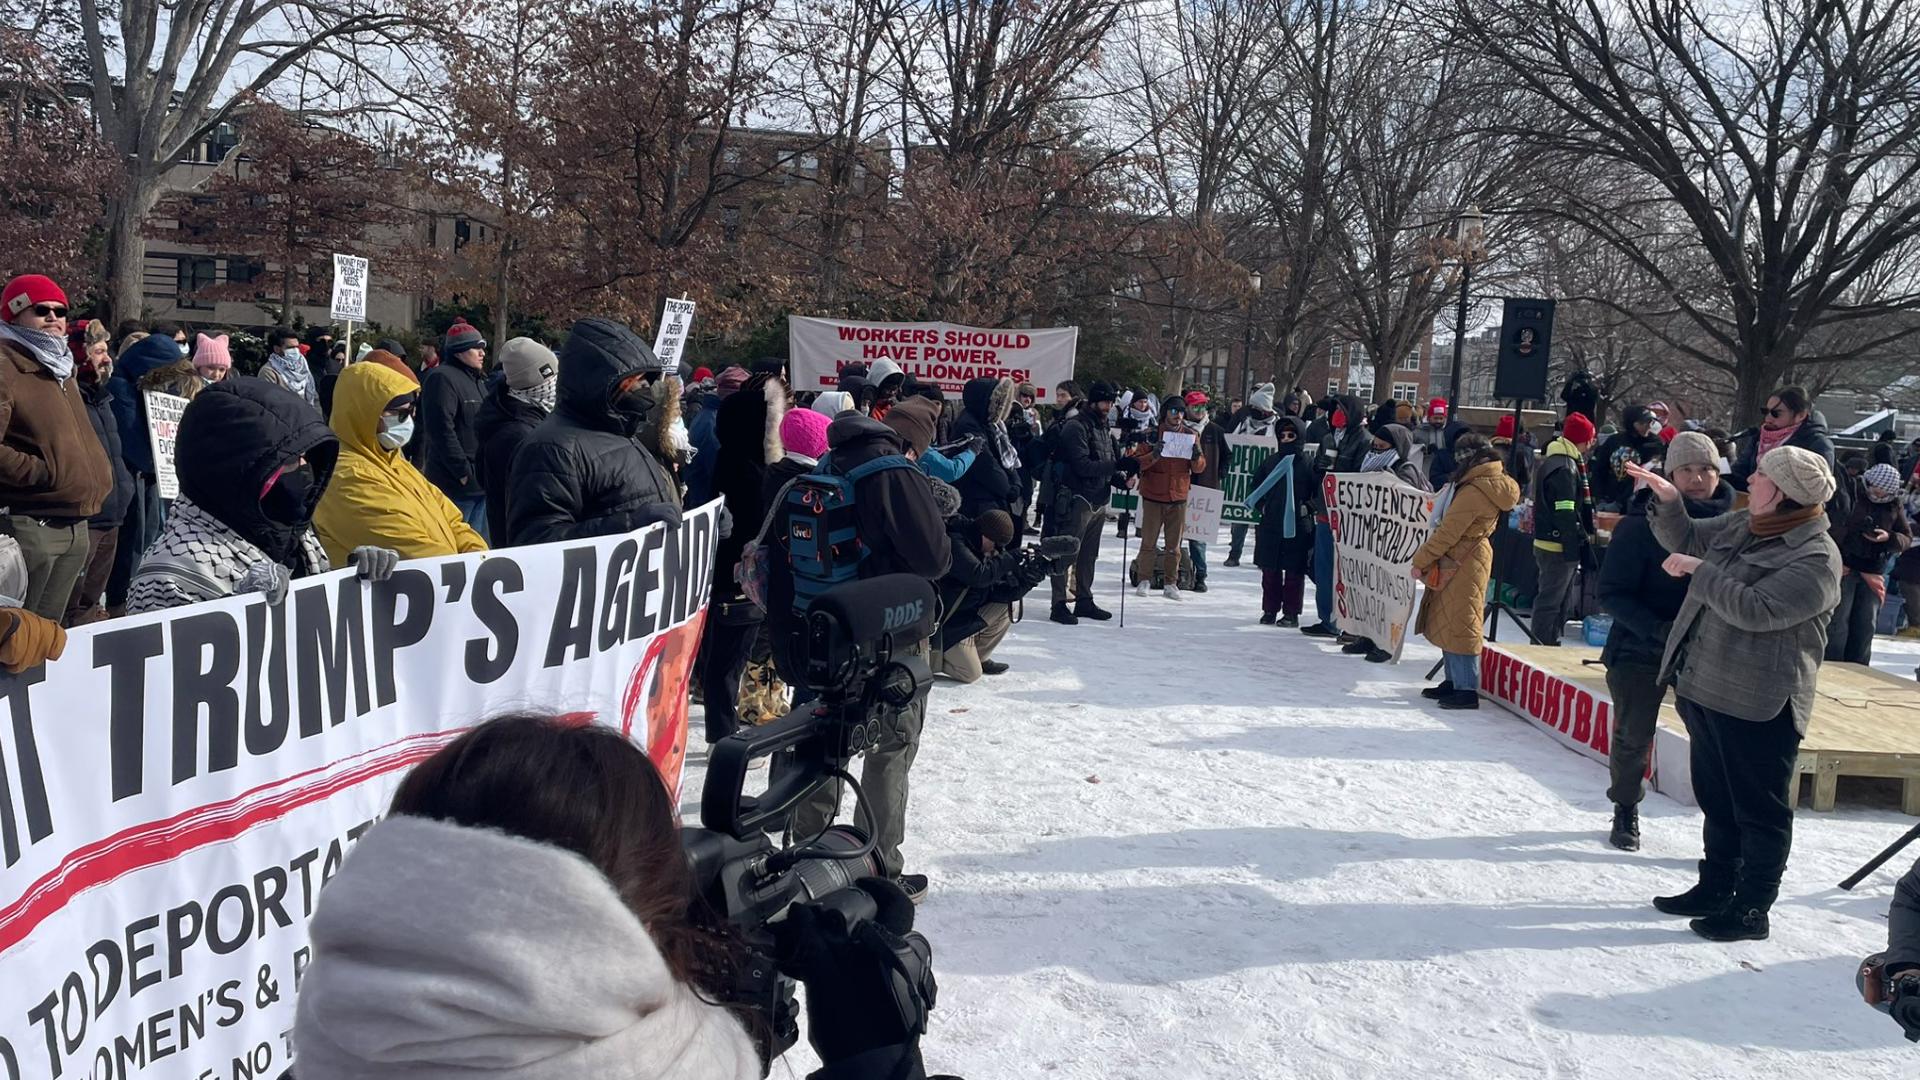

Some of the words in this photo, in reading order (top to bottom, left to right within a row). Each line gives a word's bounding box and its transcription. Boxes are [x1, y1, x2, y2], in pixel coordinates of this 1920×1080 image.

[340, 288, 352, 297] NOT
[838, 326, 939, 345] WORKERS
[945, 330, 1031, 349] SHOULD
[862, 344, 918, 361] HAVE
[923, 348, 1002, 366] POWER.
[1231, 444, 1277, 473] PEOP
[1330, 509, 1429, 564] ANTIMPERIALIS
[92, 557, 525, 803] TRUMP'S
[27, 971, 88, 1080] TO
[85, 814, 381, 1022] DEPORTA
[80, 980, 244, 1080] OMEN'S
[255, 963, 280, 1010] &
[232, 1041, 272, 1080] NO
